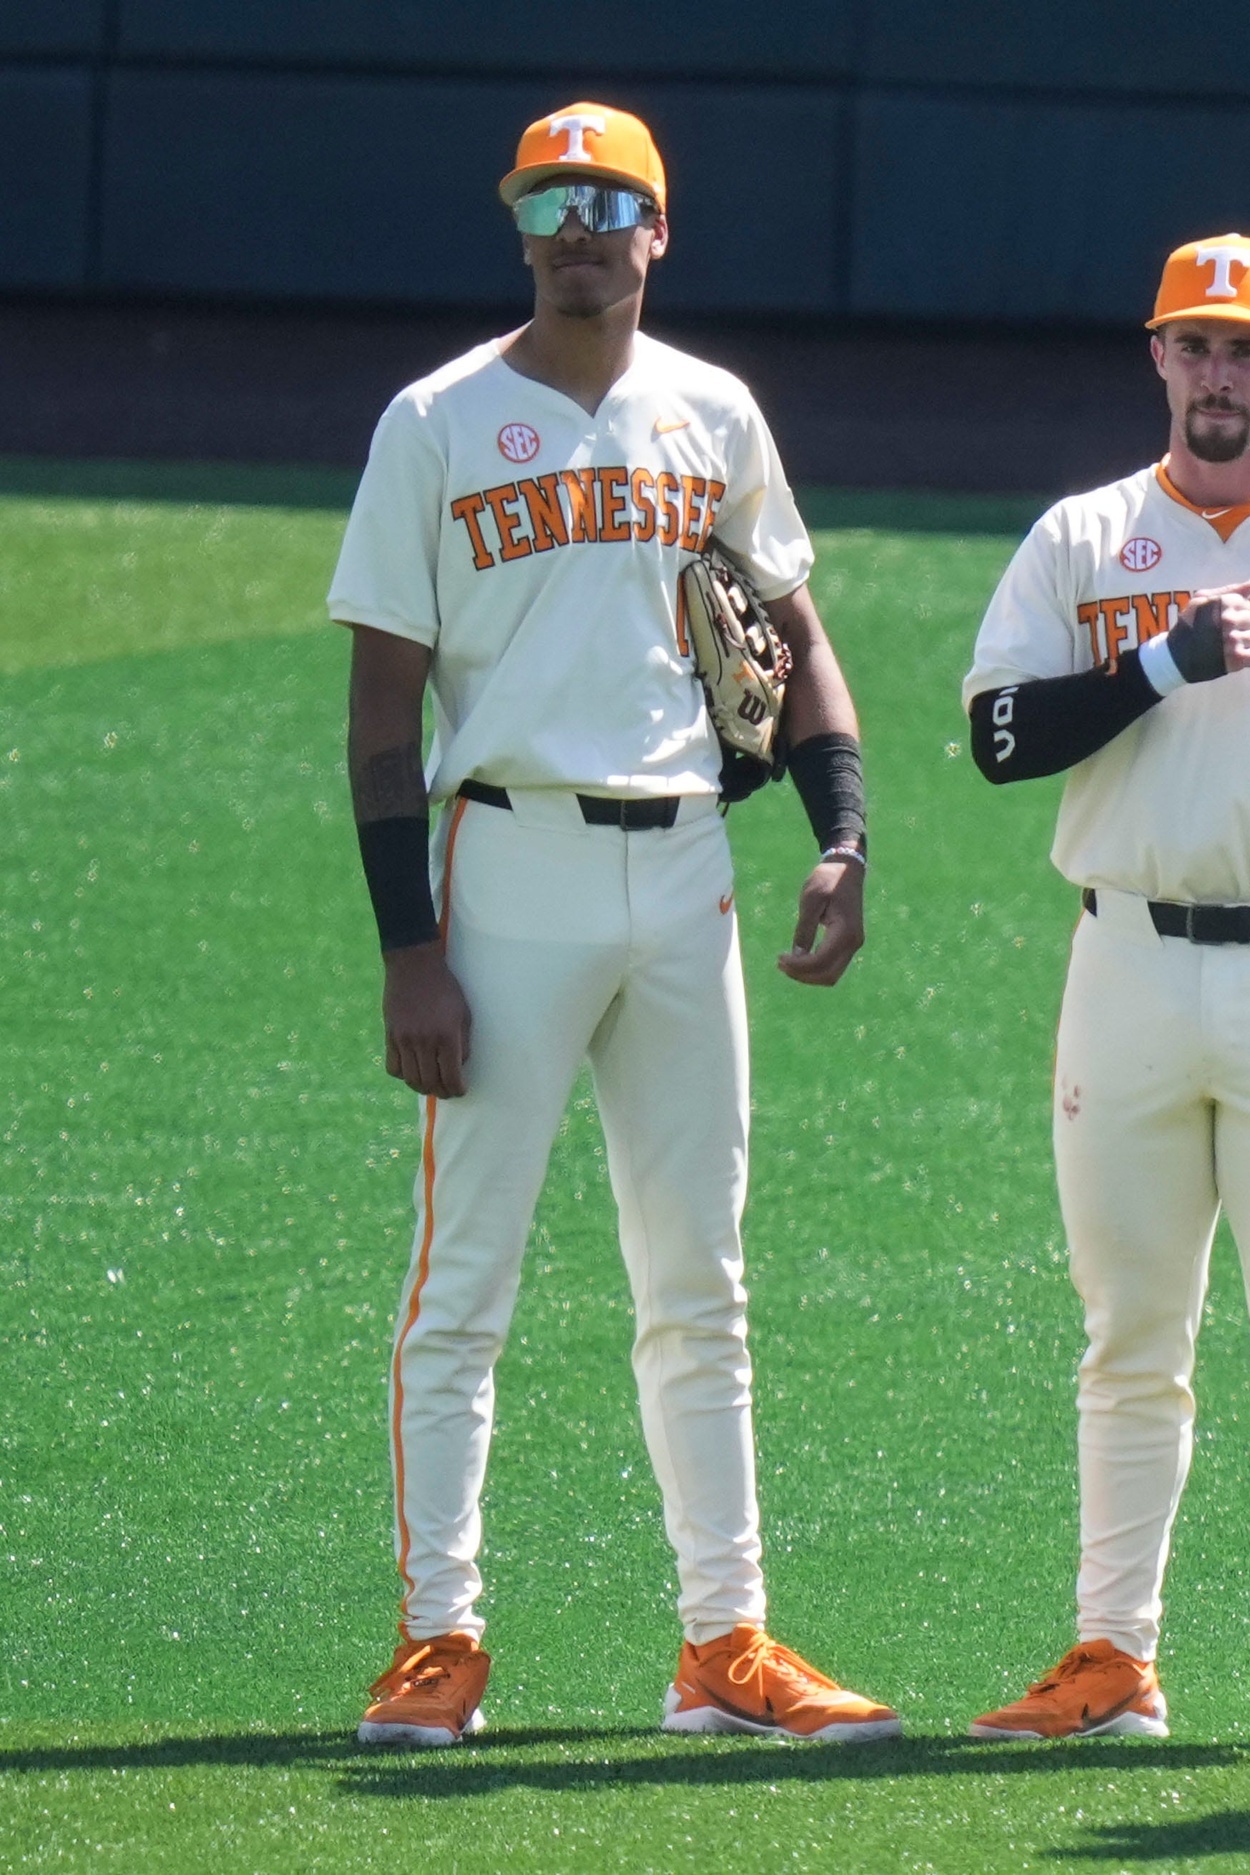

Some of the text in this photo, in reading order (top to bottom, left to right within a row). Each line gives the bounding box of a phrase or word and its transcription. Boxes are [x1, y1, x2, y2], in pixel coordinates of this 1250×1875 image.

[549, 114, 606, 162] T
[499, 424, 540, 462] SEC
[450, 466, 726, 571] TENNESSEE
[1121, 538, 1161, 571] SEC
